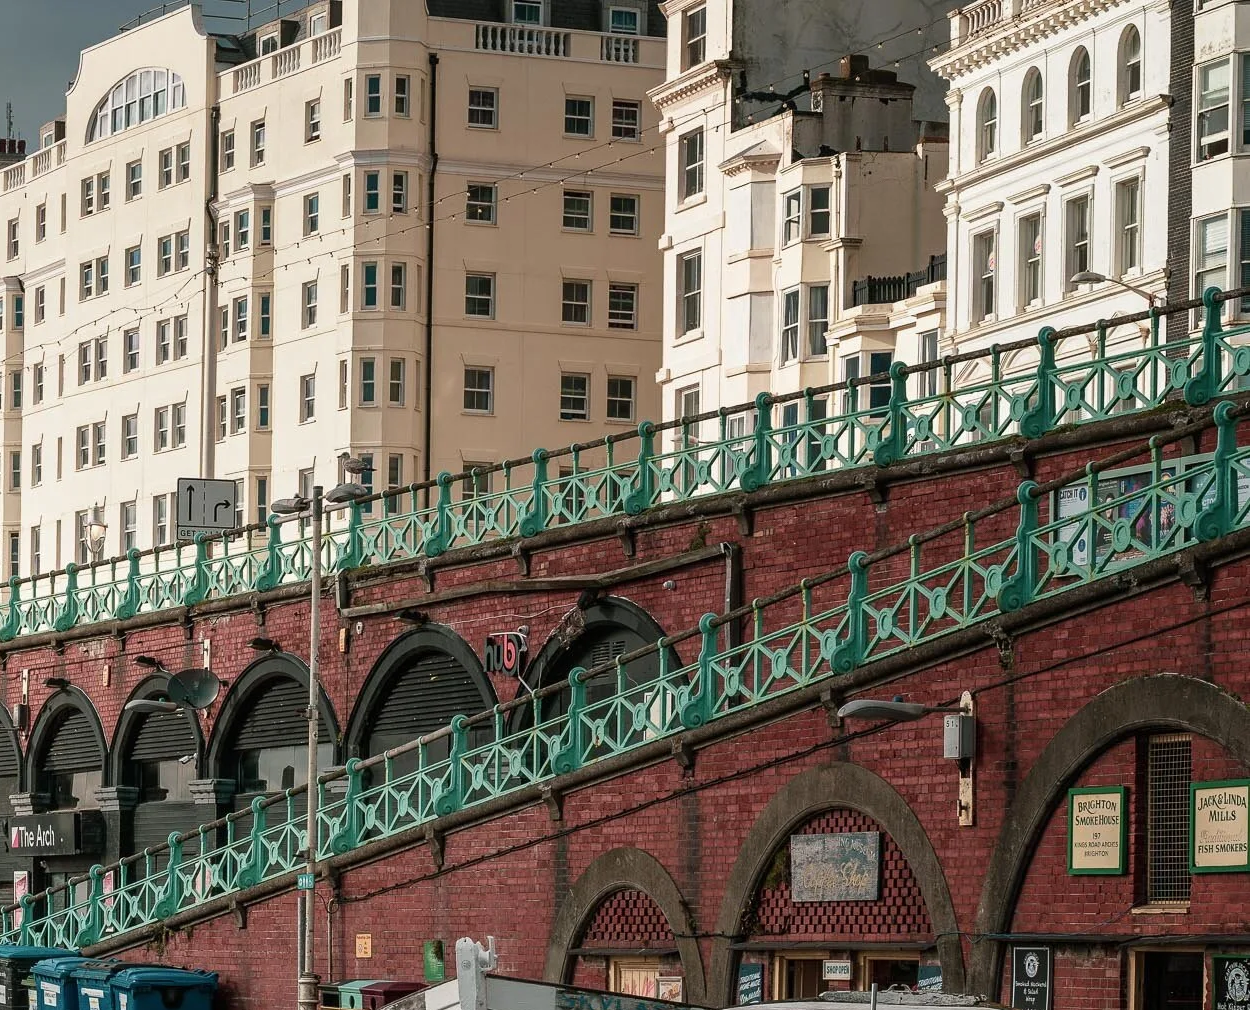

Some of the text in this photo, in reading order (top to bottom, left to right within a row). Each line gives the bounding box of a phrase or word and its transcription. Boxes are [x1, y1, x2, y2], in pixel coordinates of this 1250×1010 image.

[1059, 488, 1079, 500] CATCH IT
[483, 634, 517, 677] hub
[1077, 799, 1117, 814] BRIGHTON
[1208, 810, 1237, 822] MILLS
[19, 824, 55, 847] The Arch
[1197, 842, 1248, 854] FISH SMOKERS
[826, 964, 849, 975] SHOP OPEN
